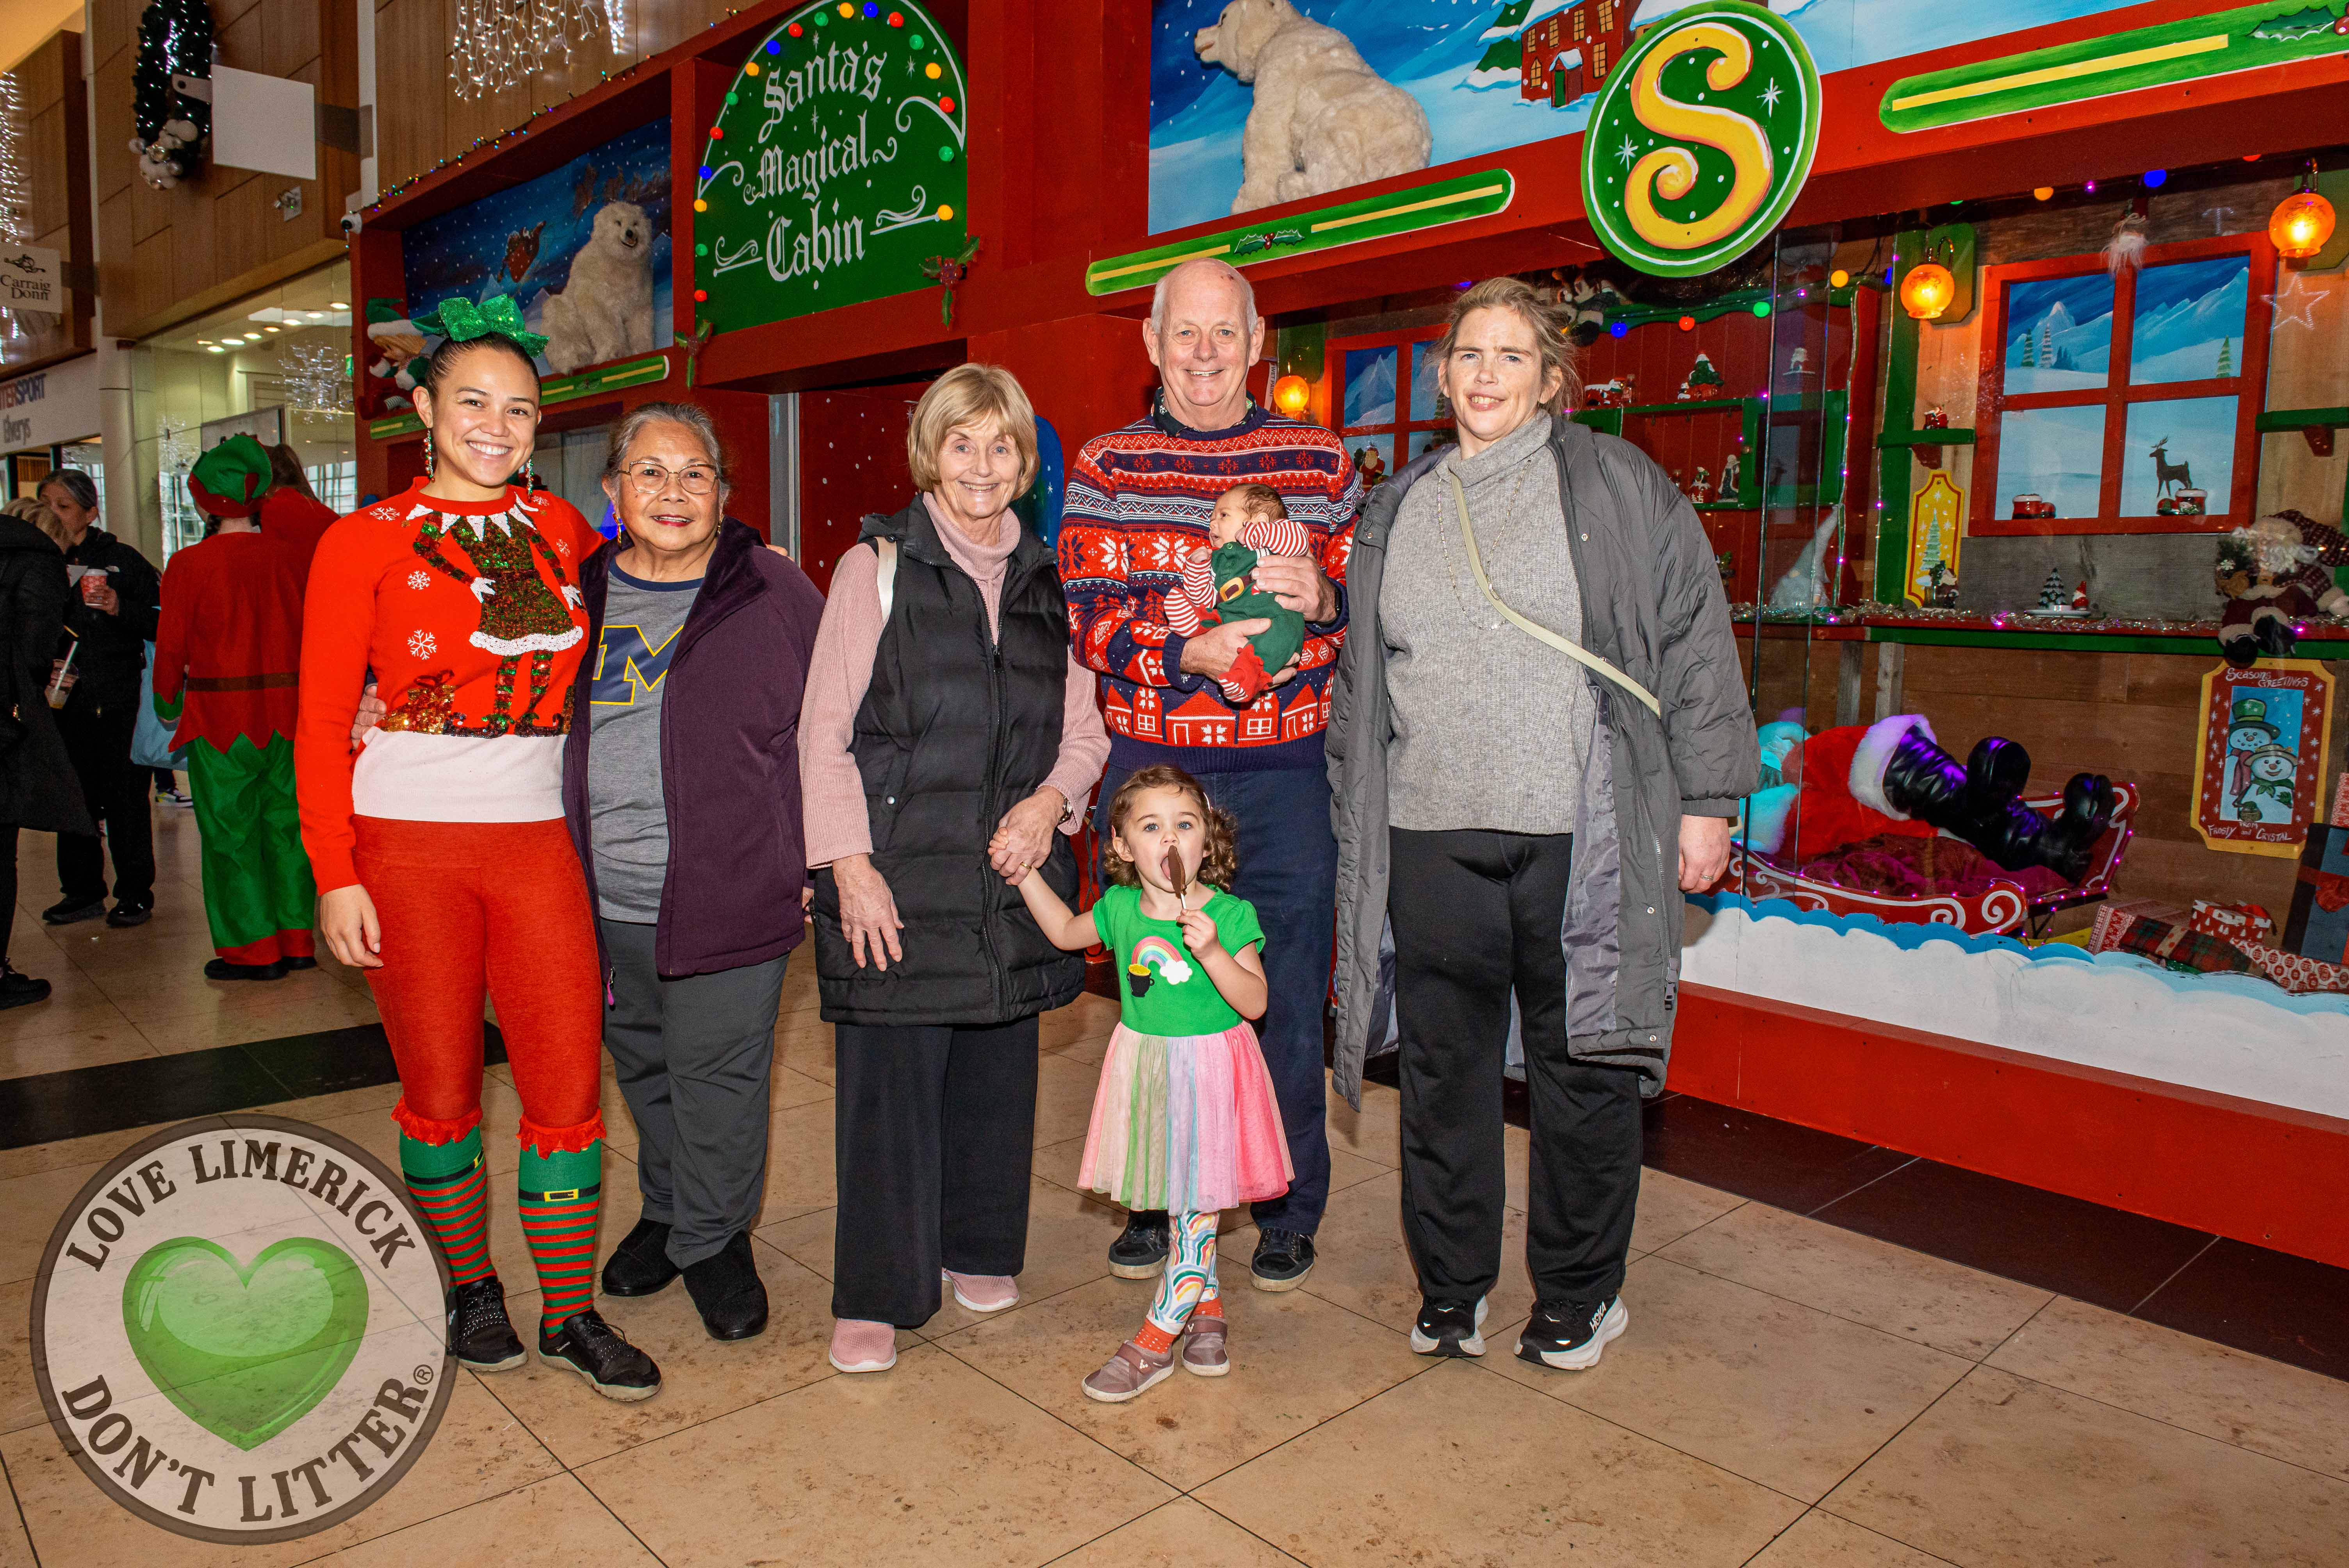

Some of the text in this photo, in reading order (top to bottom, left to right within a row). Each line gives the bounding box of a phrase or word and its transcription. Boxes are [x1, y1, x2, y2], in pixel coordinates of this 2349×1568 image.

[758, 41, 887, 143] Santa's
[743, 110, 872, 205] Magical
[1625, 22, 1773, 249] S
[766, 198, 866, 282] Cabin
[0, 274, 51, 292] Carraig
[11, 287, 48, 300] Donn
[2258, 676, 2309, 687] GREETINGS
[1589, 1301, 1607, 1334] HOKA
